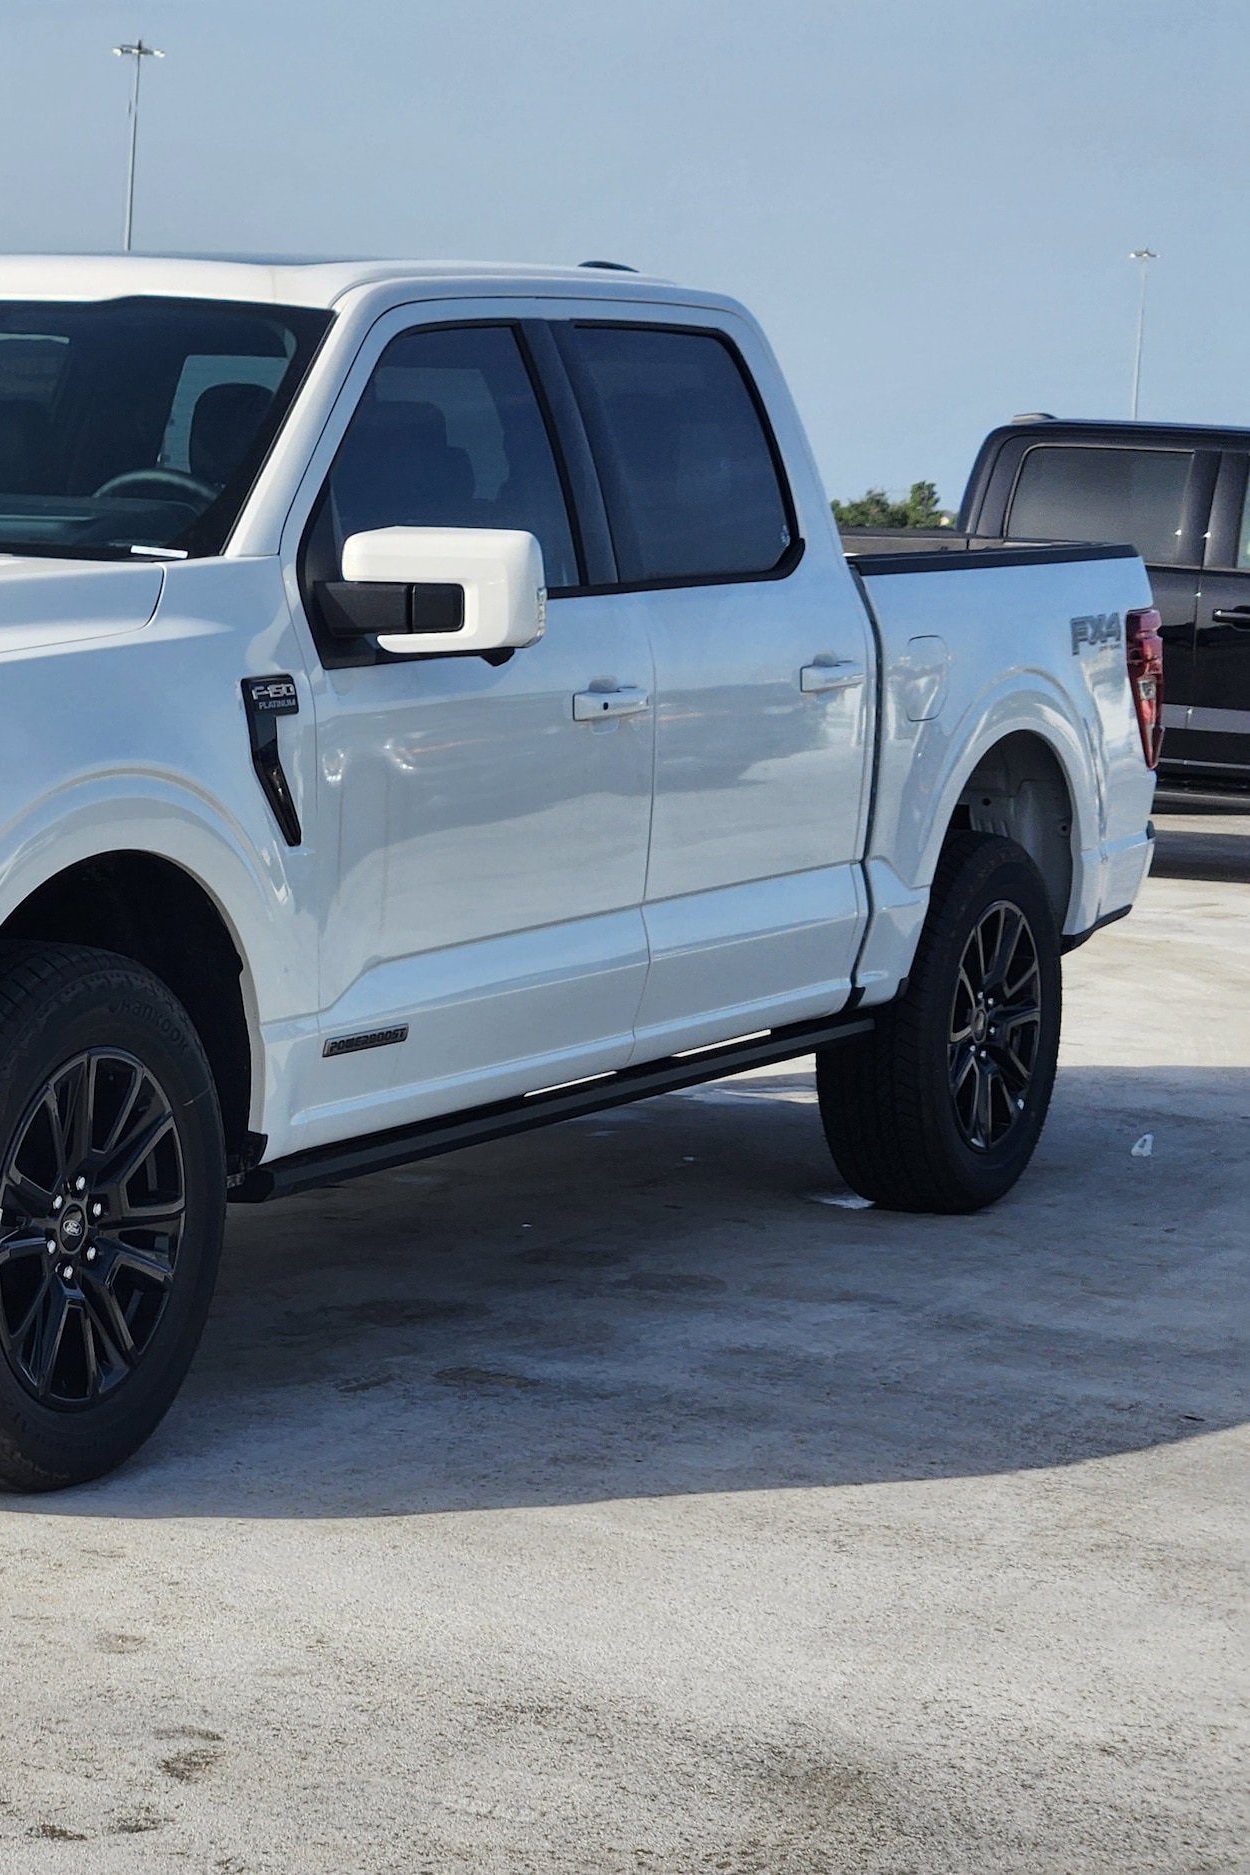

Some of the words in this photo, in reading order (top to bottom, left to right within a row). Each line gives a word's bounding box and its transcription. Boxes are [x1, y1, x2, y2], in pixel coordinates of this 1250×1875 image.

[1070, 612, 1121, 655] FX4
[252, 684, 296, 700] F-150
[259, 698, 296, 710] PLATINUM
[330, 1028, 407, 1052] POWERBOOST
